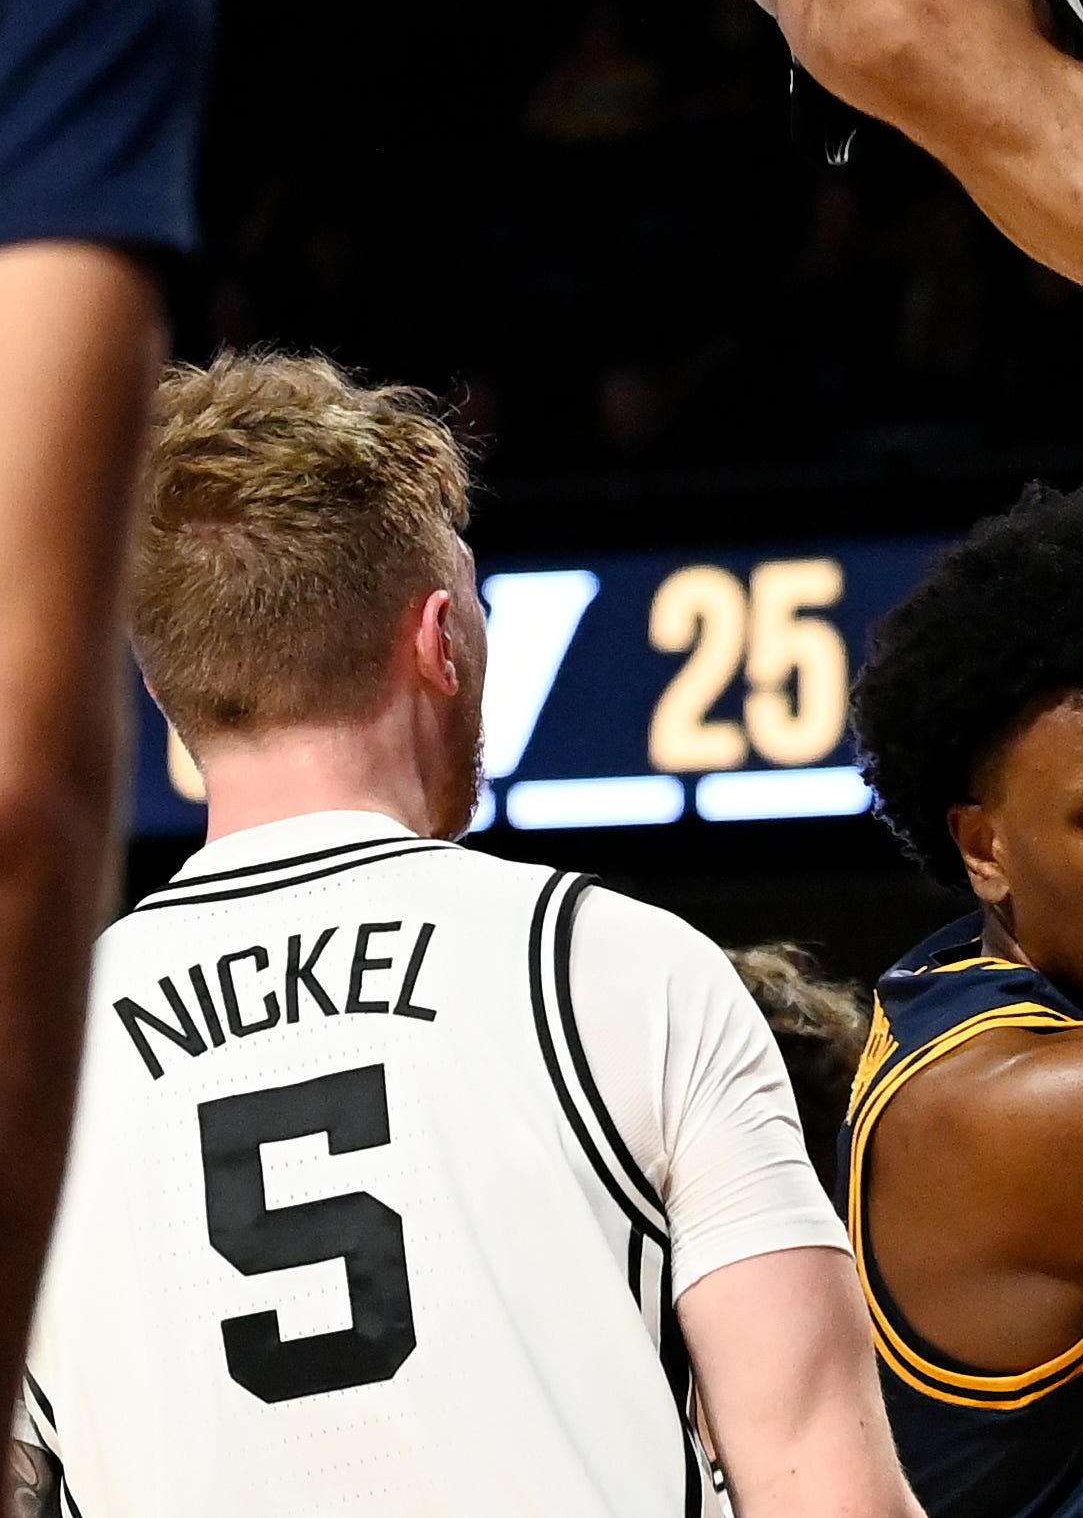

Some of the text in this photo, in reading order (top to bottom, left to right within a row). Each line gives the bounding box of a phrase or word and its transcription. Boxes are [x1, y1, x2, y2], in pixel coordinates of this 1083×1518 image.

[650, 557, 848, 772] 25
[112, 920, 437, 1080] NICKEL
[197, 1063, 417, 1404] 5
